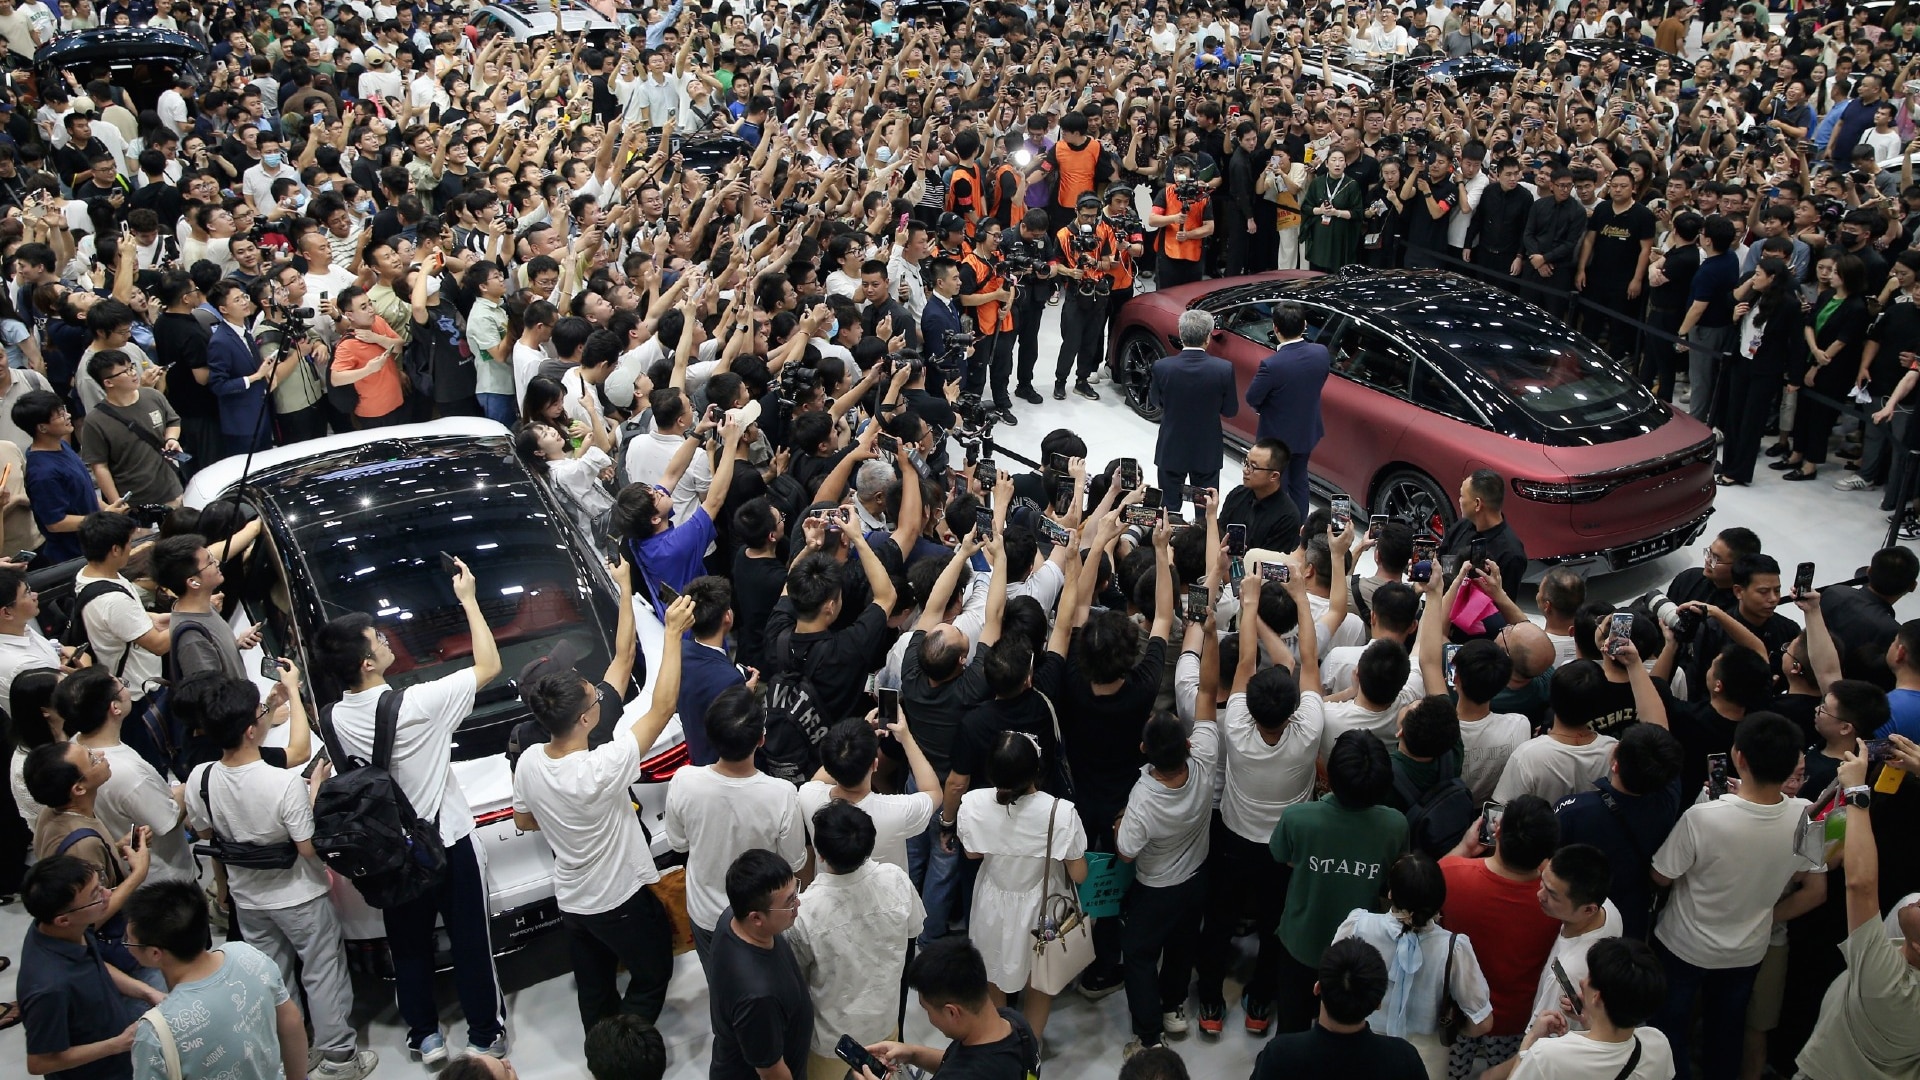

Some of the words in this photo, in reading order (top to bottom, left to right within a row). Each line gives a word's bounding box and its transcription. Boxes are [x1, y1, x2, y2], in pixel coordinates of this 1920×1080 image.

[1309, 855, 1381, 879] STAFF
[515, 910, 544, 927] HI
[181, 1037, 205, 1053] SMR
